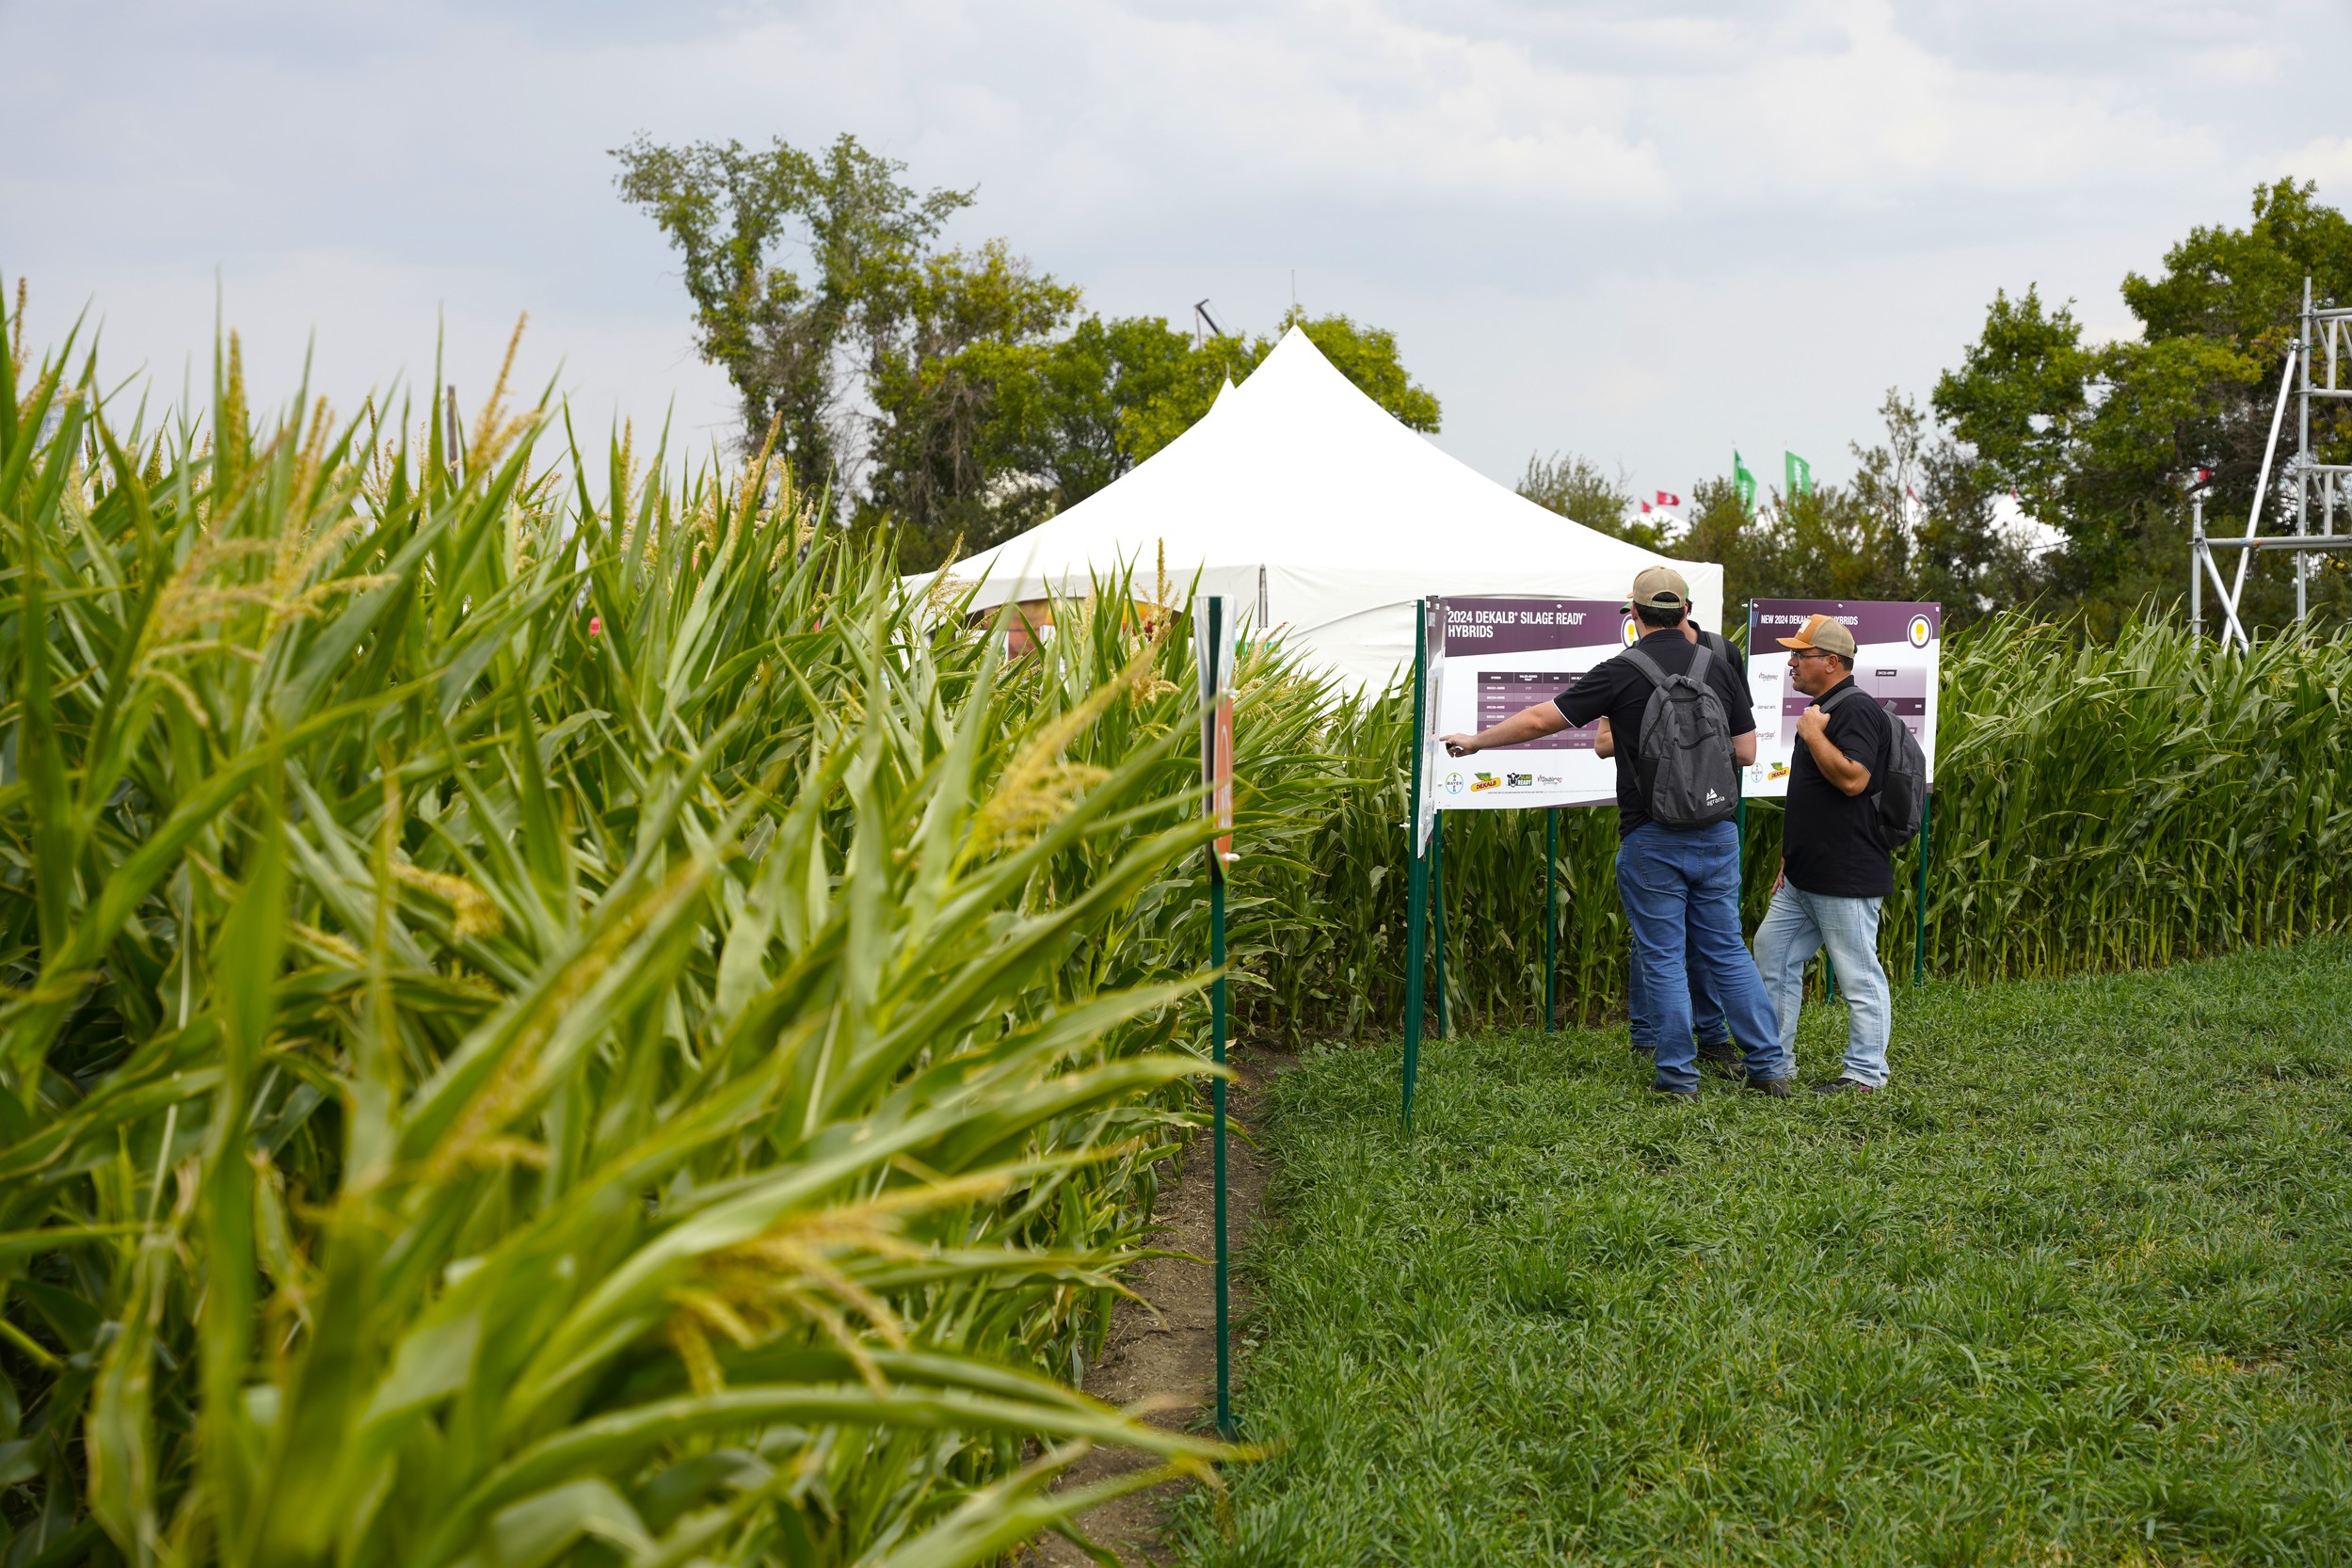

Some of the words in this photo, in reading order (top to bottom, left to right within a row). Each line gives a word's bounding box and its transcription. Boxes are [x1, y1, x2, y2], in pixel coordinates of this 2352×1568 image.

[1448, 611, 1473, 624] 2024
[1521, 612, 1554, 625] SILAGE
[1761, 615, 1774, 624] NEW
[1775, 615, 1788, 625] 2024
[1833, 616, 1859, 626] YBRIDS
[1448, 625, 1494, 638] HYBRIDS
[1771, 770, 1787, 778] DEKALB
[1476, 781, 1497, 791] DEKALB
[1706, 796, 1725, 807] agraria
